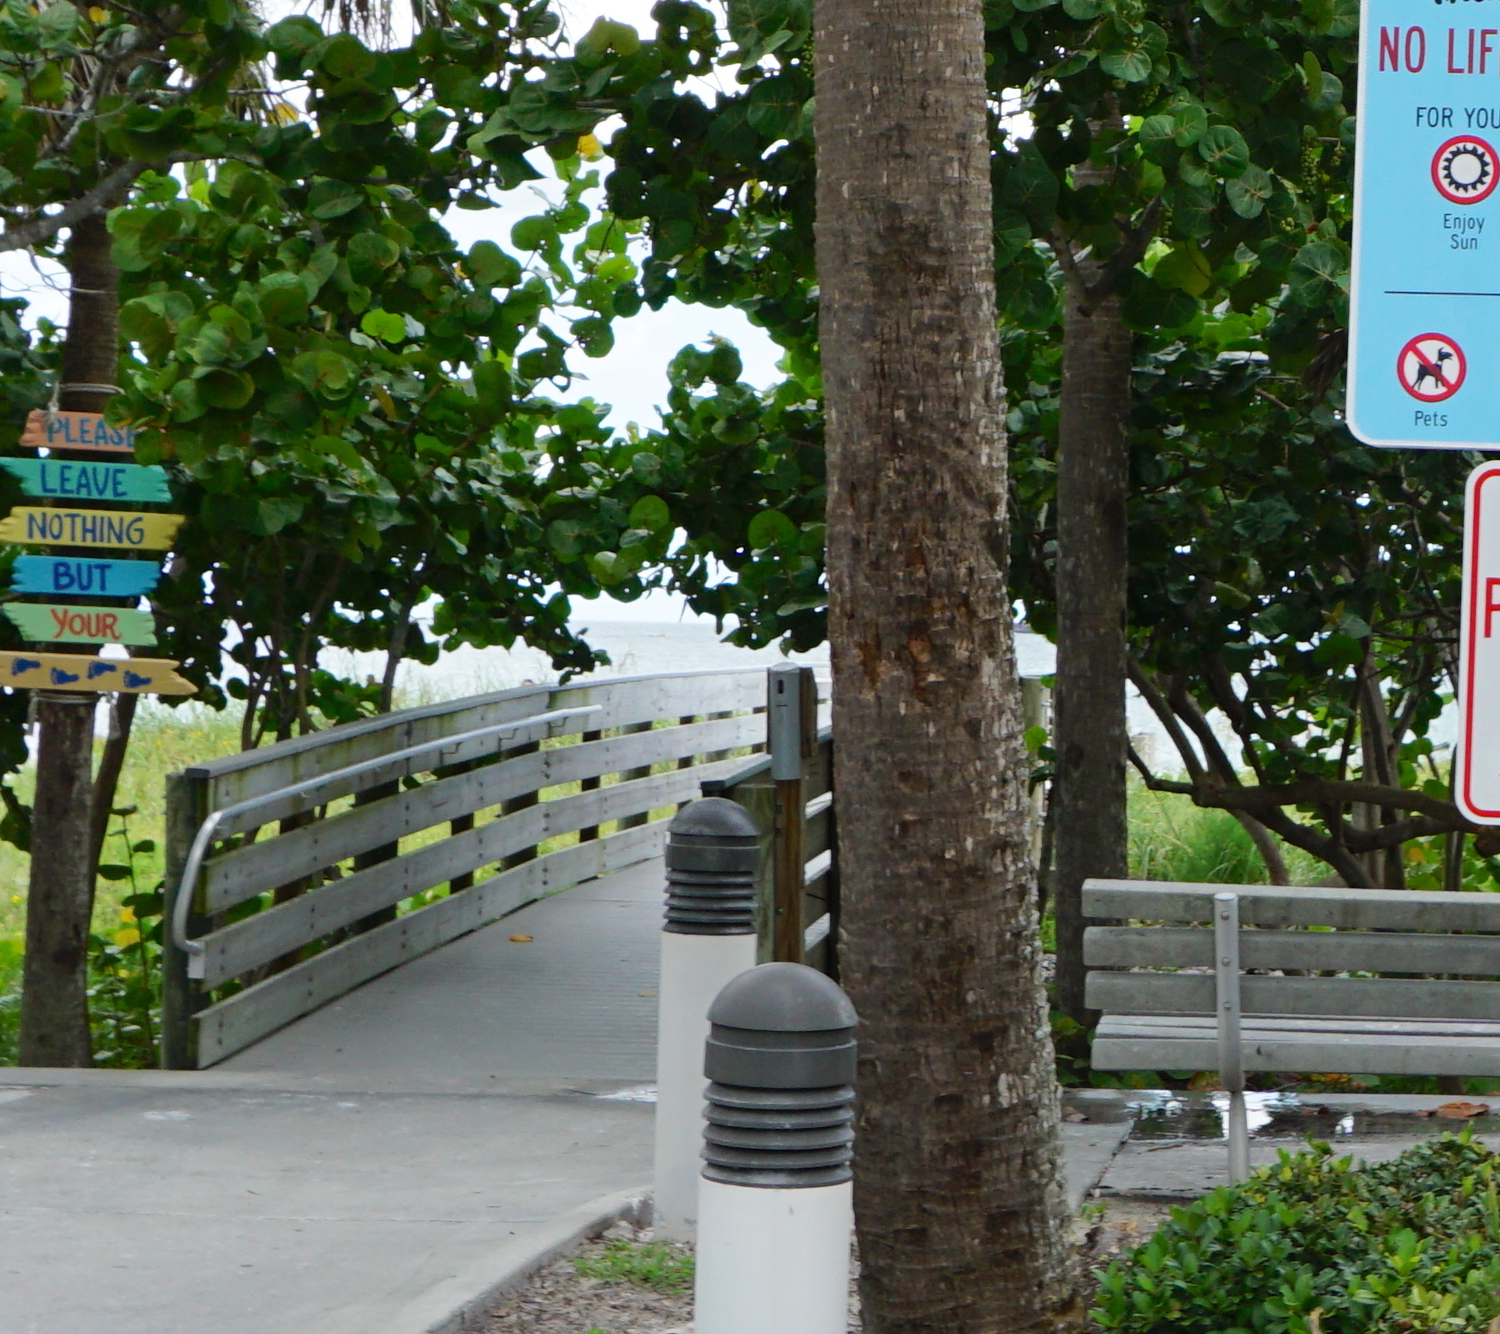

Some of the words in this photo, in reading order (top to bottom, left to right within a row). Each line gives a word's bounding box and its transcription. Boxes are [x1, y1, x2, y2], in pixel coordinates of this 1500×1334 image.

[1379, 25, 1426, 73] NO
[1415, 106, 1454, 129] FOR
[1443, 213, 1486, 234] Enjoy
[1449, 233, 1479, 251] Sun
[1414, 411, 1448, 428] Pets
[40, 464, 128, 498] LEAVE
[27, 512, 145, 545] NOTHING
[53, 562, 112, 592] BUT
[50, 608, 123, 640] YOUR
